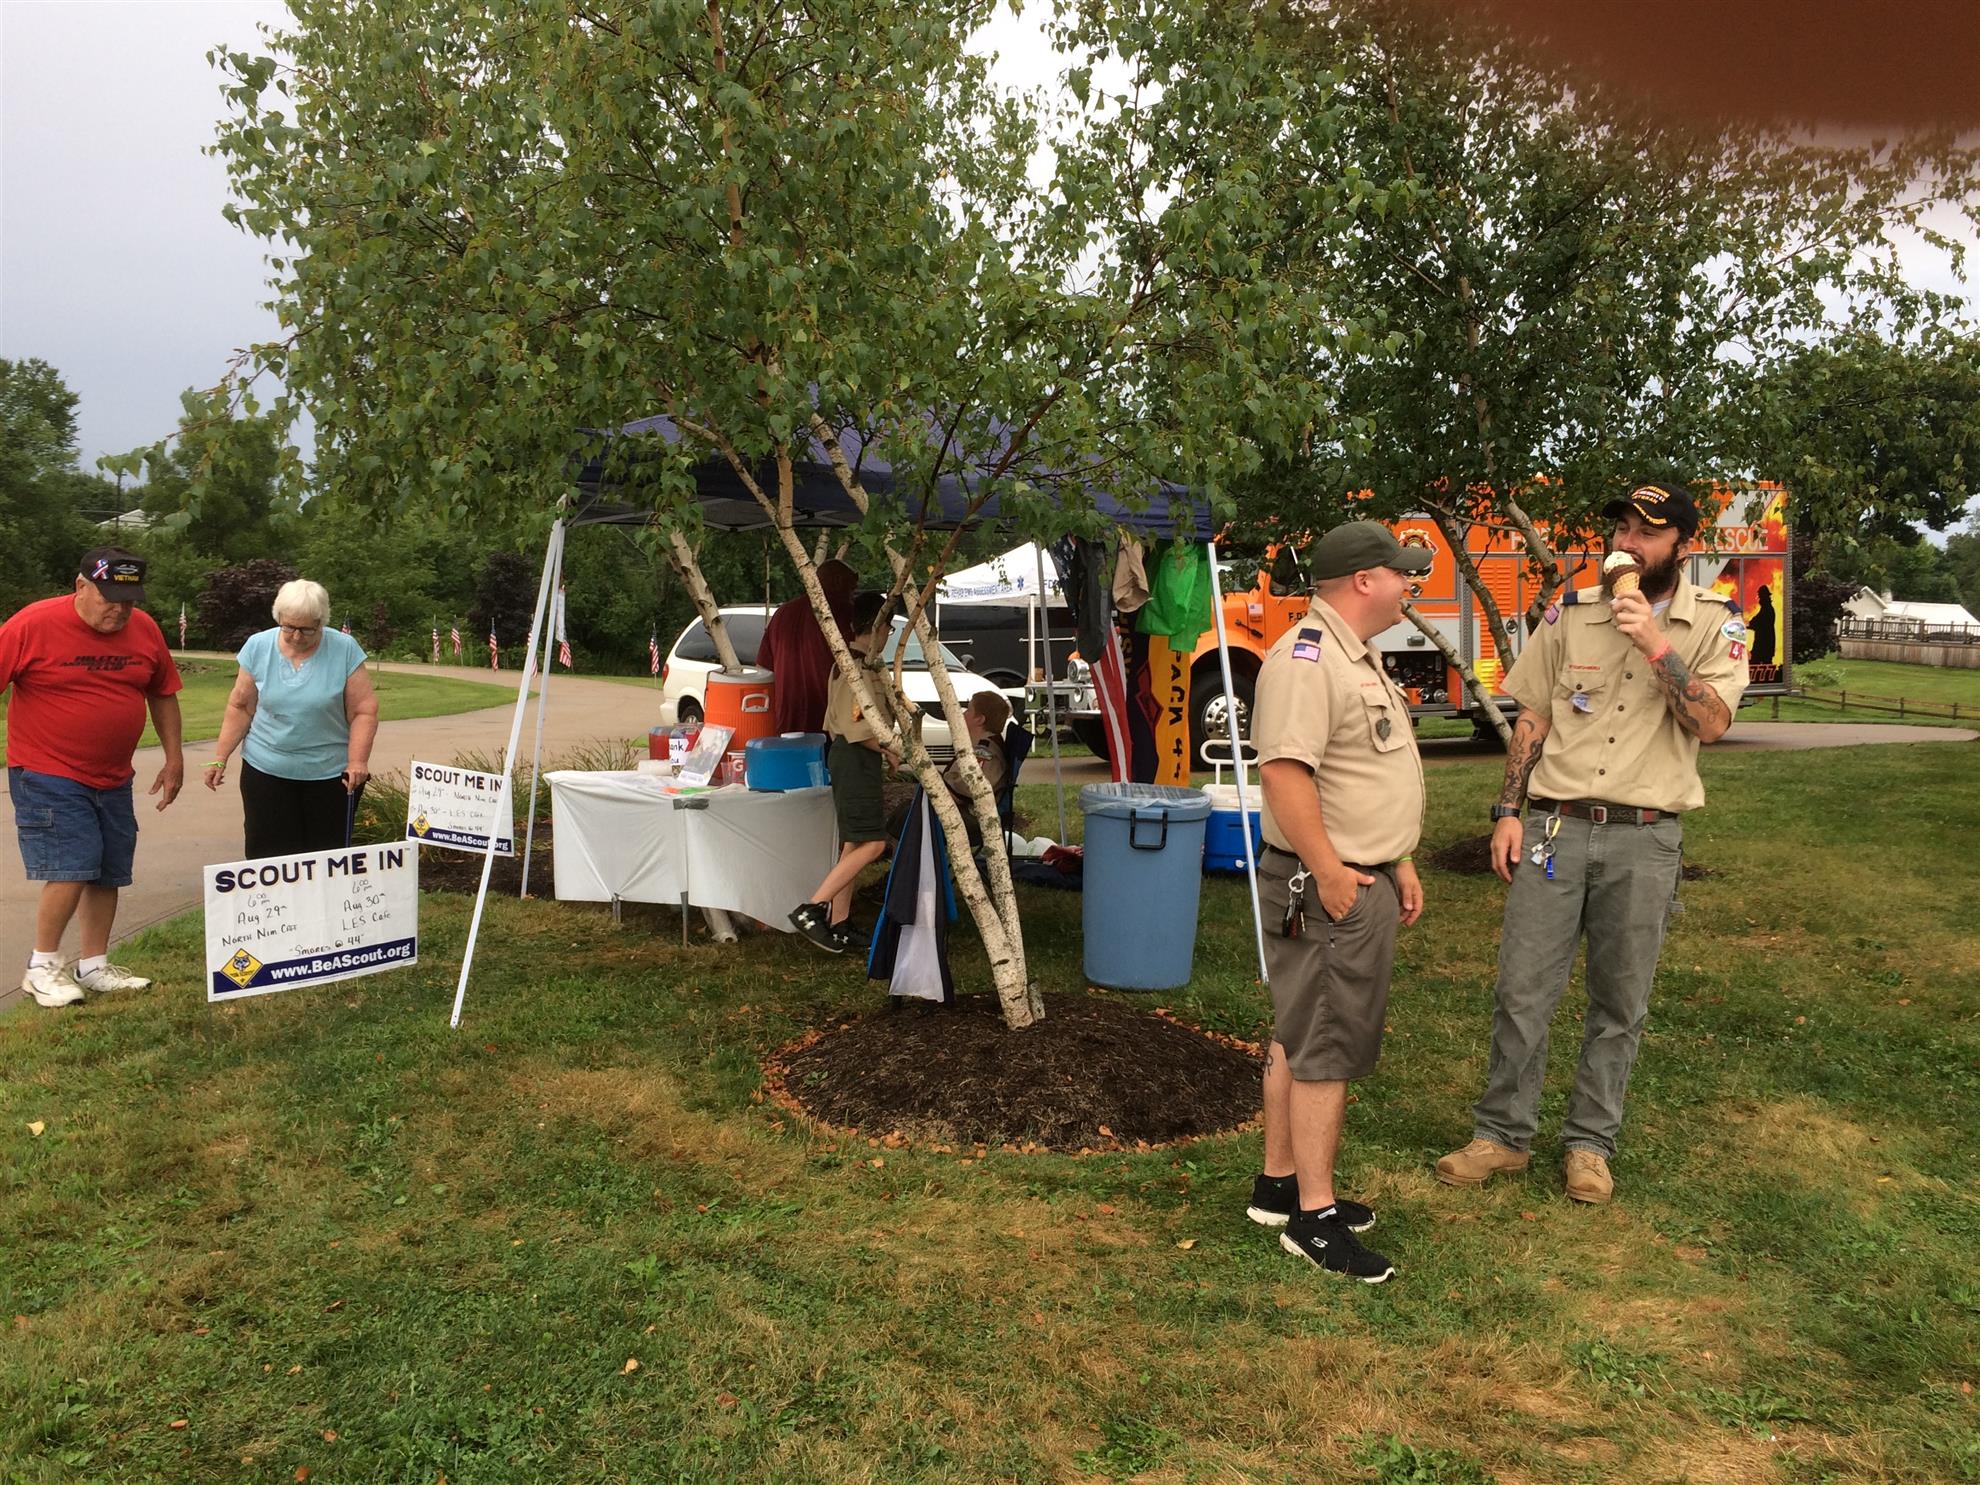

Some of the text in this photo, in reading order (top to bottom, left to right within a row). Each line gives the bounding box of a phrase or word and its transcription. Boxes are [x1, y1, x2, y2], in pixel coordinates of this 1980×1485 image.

[415, 766, 503, 792] SCOUT ME IN
[432, 831, 509, 851] www.BeAScouorg
[215, 848, 404, 893] SCOUT ME IN
[343, 899, 363, 913] Aug
[237, 911, 260, 925] Aug
[270, 942, 411, 980] www.BeAScout.org
